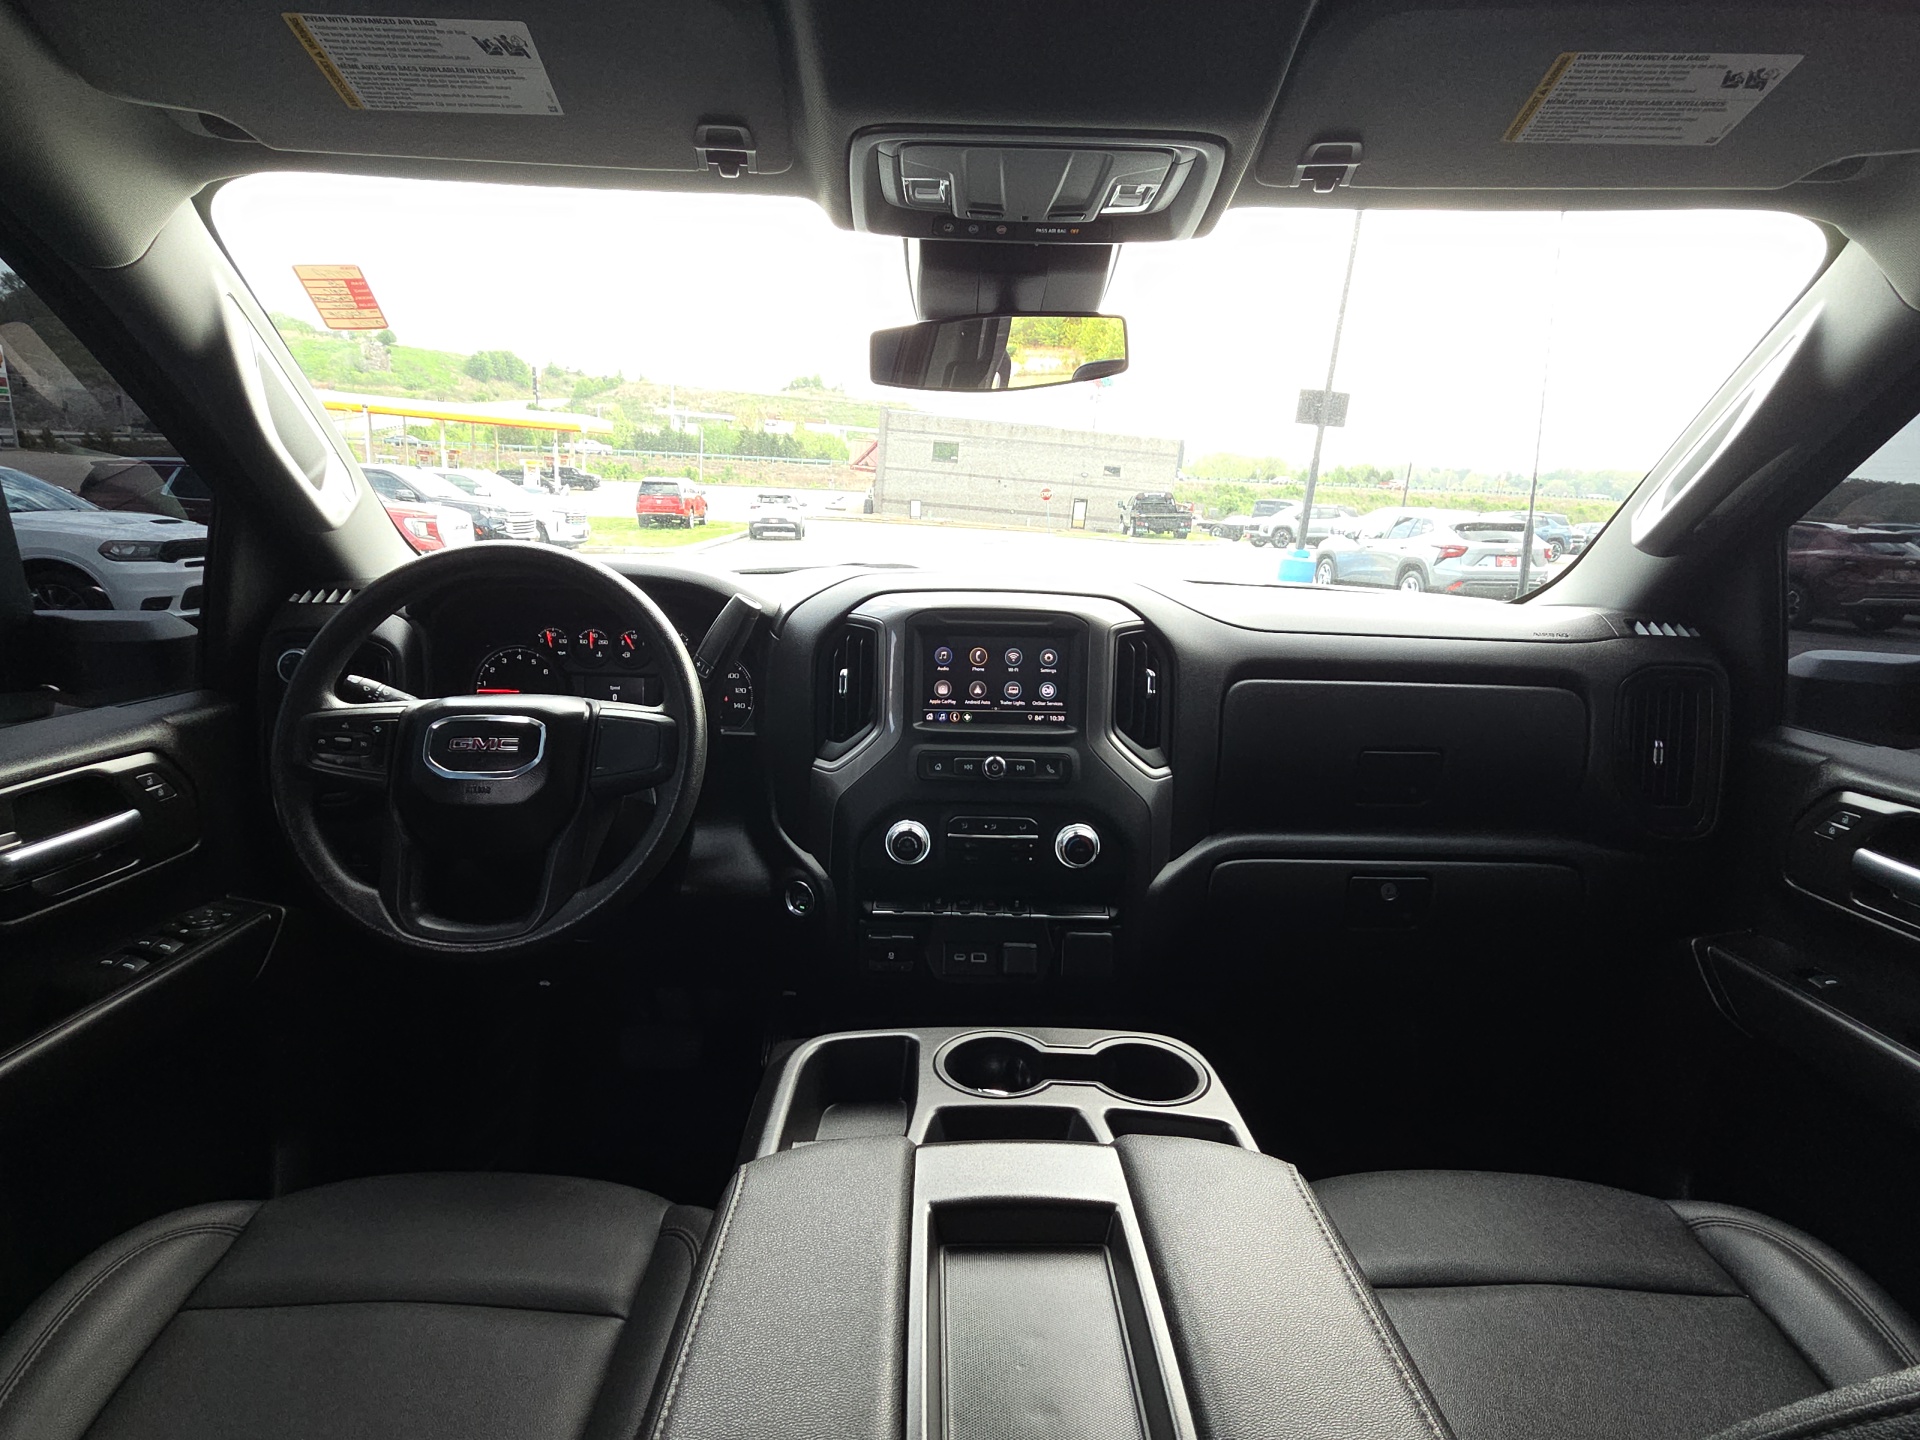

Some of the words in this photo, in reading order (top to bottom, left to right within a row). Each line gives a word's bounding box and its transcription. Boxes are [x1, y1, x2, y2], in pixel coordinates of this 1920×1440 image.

[351, 17, 396, 25] ADVANCED
[413, 19, 437, 27] BAGS
[448, 737, 519, 752] GMC
